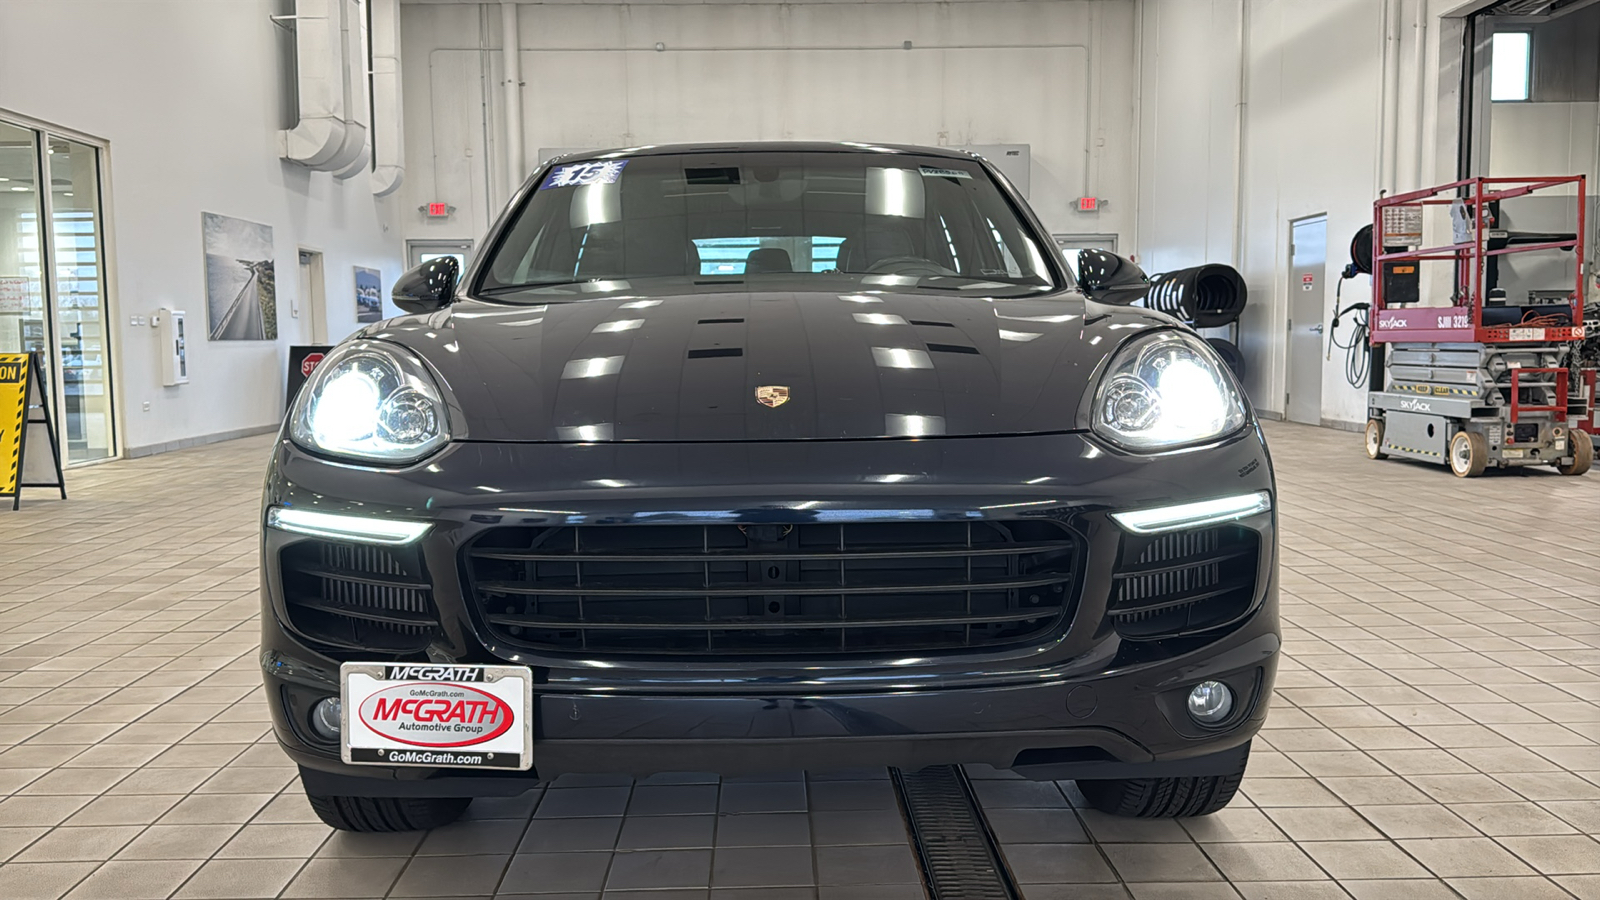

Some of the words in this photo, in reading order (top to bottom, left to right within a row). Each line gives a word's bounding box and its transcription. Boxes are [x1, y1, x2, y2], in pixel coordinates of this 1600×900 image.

[569, 166, 604, 181] 15
[1081, 197, 1096, 210] EXIT
[1379, 316, 1407, 329] SKYJACK
[303, 361, 319, 372] ST
[1400, 398, 1431, 412] SKYJACK
[409, 689, 465, 698] GoMcGrath.com
[398, 721, 452, 732] Automotive
[453, 723, 483, 734] Group
[388, 750, 482, 765] GoMcGrath.com
